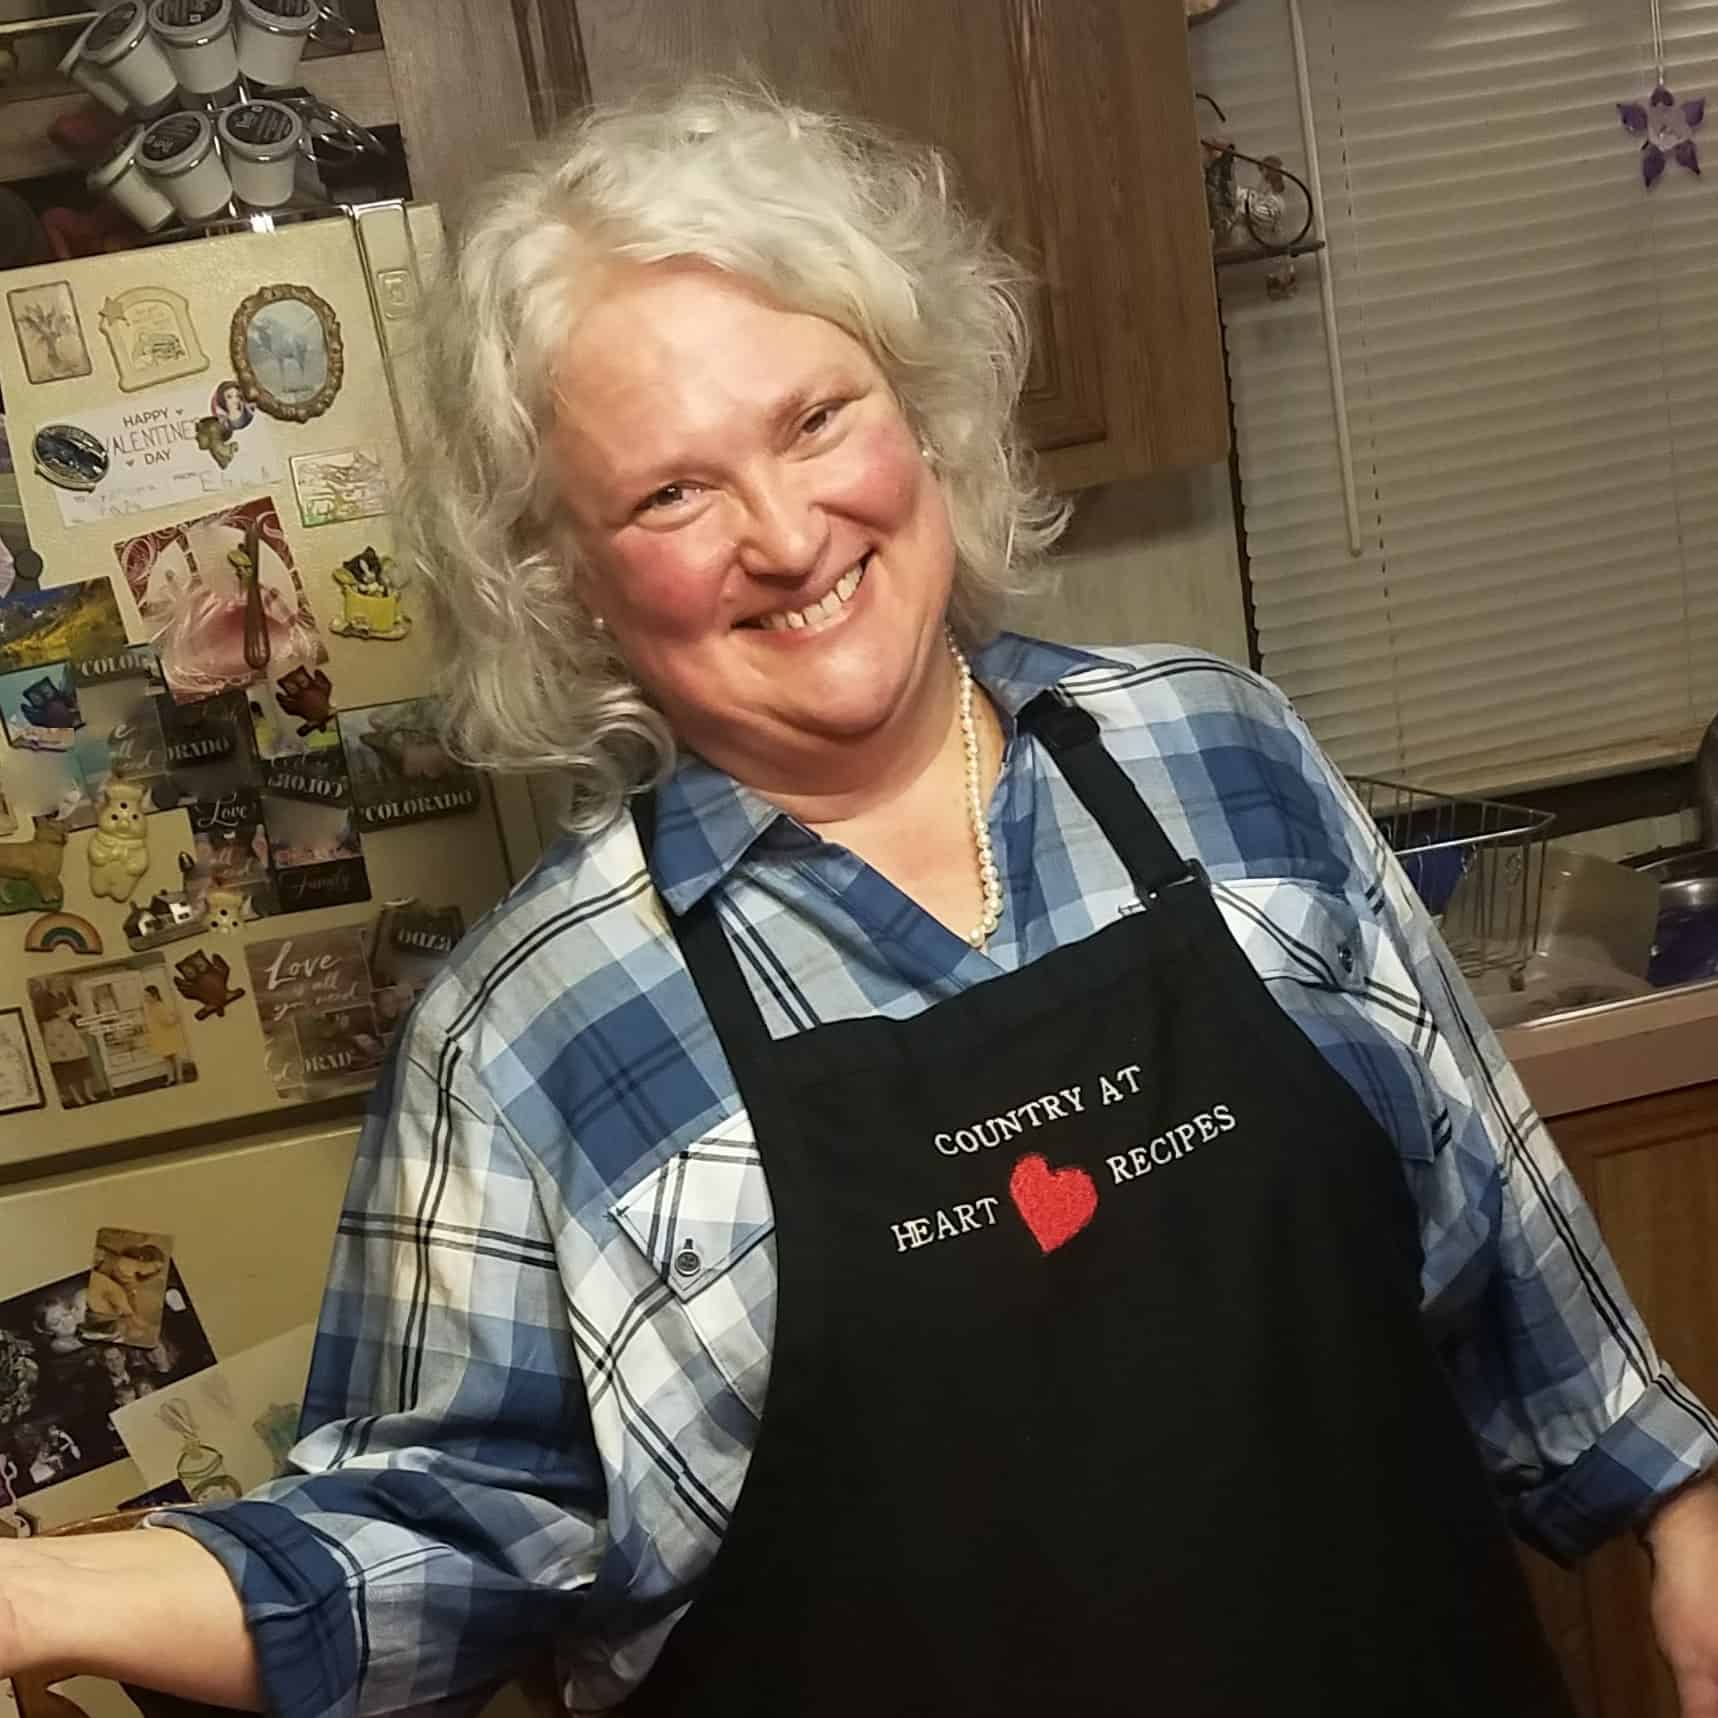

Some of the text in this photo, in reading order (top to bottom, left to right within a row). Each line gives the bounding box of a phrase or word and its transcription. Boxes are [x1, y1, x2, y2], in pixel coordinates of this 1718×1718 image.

[123, 408, 169, 427] HAPPY
[144, 448, 171, 465] DAY
[198, 792, 248, 828] Love
[364, 790, 473, 822] COLORADO
[264, 941, 341, 990] Love
[934, 1065, 1142, 1156] COUNTRY AT
[890, 1104, 1236, 1252] HEART RECIPES
